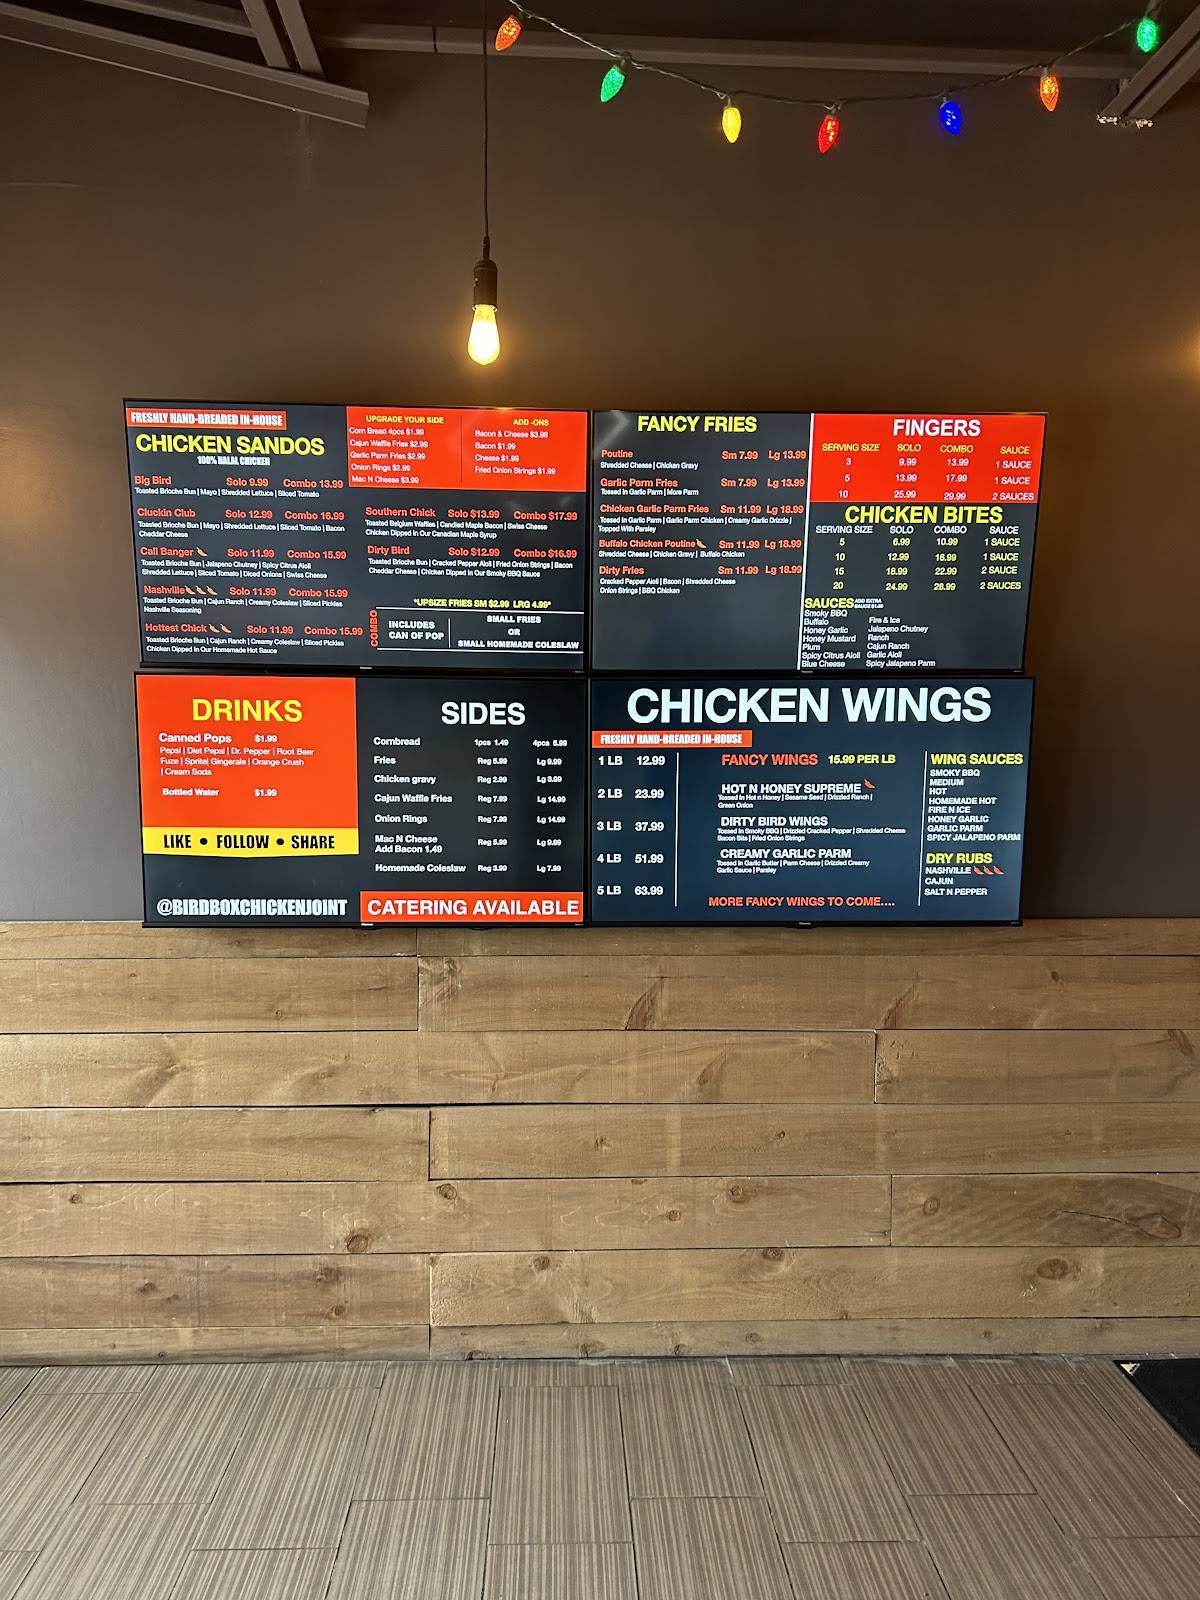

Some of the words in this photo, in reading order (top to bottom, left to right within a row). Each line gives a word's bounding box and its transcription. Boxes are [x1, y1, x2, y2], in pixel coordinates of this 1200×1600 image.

[131, 412, 168, 423] FRESHLY
[170, 413, 238, 425] HAND-BREADED
[240, 415, 282, 426] IN-HOUSE
[638, 416, 699, 432] FANCY
[704, 417, 757, 432] FRIES
[893, 420, 981, 436] FINGERS
[136, 434, 231, 453] CHICKEN
[237, 437, 325, 456] SANDOS
[822, 444, 859, 452] SERVING
[861, 444, 880, 452] SIZE
[897, 444, 921, 452] SOLO
[940, 445, 973, 453] COMBO
[601, 450, 633, 458] Poutine
[722, 451, 737, 459] Sm
[739, 451, 758, 459] 7.99
[769, 451, 781, 460] Lg
[783, 451, 806, 459] 13.99
[197, 456, 217, 465] 100%
[217, 456, 238, 465] HALAL
[240, 457, 270, 466] CHICKEN
[372, 465, 390, 473] Rings
[134, 476, 149, 486] Big
[152, 476, 171, 485] Bird
[226, 478, 247, 486] Solo
[249, 478, 268, 486] 9.99
[283, 479, 317, 488] Combo
[319, 480, 343, 488] 13.99
[896, 474, 917, 482] 13.99
[160, 488, 183, 496] Brioche
[200, 489, 217, 497] Mayo
[366, 508, 407, 517] Southern
[410, 508, 436, 517] Chick
[448, 509, 468, 518] Solo
[471, 510, 499, 519] $13.99
[514, 511, 546, 520] Combo
[548, 512, 578, 521] $17.99
[845, 506, 937, 523] CHICKEN
[944, 506, 1003, 523] BITES
[599, 567, 620, 575] Dirty
[718, 566, 733, 574] Sm
[735, 566, 758, 574] 11.99
[766, 566, 777, 576] Lg
[779, 566, 802, 574] 18.99
[833, 582, 843, 590] 20
[980, 582, 985, 590] 2
[987, 582, 1021, 590] SAUCES
[805, 599, 854, 608] SAUCES
[146, 624, 179, 632] Hottest
[181, 624, 207, 632] Chick
[247, 625, 267, 634] Solo
[270, 625, 293, 634] 11.99
[305, 626, 337, 635] Combo
[340, 627, 363, 635] 15.99
[369, 610, 378, 646] COMBO
[389, 621, 435, 629] INCLUDES
[389, 632, 410, 640] CAN
[412, 632, 424, 640] OF
[425, 632, 444, 640] POP
[867, 643, 887, 651] Cajun
[627, 687, 829, 723] CHICKEN
[842, 687, 991, 723] WINGS
[192, 699, 302, 722] DRINKS
[441, 702, 525, 725] SIDES
[159, 734, 201, 742] Canned
[204, 734, 232, 744] Pops
[255, 734, 277, 743] $1.99
[374, 738, 420, 746] Cornbread
[474, 739, 491, 747] 1pcs
[601, 735, 635, 744] FRESHLY
[637, 734, 701, 744] HAND-BREADED
[703, 734, 743, 744] IN-HOUSE
[160, 747, 181, 755] Pepsi
[244, 748, 271, 756] Pepper
[598, 757, 604, 765] 1
[608, 757, 623, 765] LB
[636, 757, 665, 765] 12.99
[722, 755, 768, 765] FANCY
[772, 755, 818, 765] WINGS
[828, 755, 855, 763] 15.99
[857, 755, 879, 763] PER
[881, 755, 896, 763] LB
[931, 754, 966, 764] WING
[970, 754, 1023, 764] SAUCES
[163, 788, 192, 796] Bottled
[255, 789, 277, 797] $1.99
[598, 790, 605, 798] 2
[607, 789, 623, 798] LB
[635, 790, 664, 798] 23.99
[722, 784, 747, 793] HOT
[749, 784, 757, 793] N
[761, 784, 801, 793] HONEY
[804, 784, 861, 793] SUPREME
[164, 835, 192, 848] LIKE
[217, 835, 269, 848] FOLLOW
[291, 836, 335, 848] SHARE
[926, 853, 953, 863] DRY
[956, 853, 992, 863] RUBS
[376, 864, 425, 872] Homemade
[427, 864, 466, 872] Coleslaw
[709, 898, 743, 906] MORE
[746, 897, 784, 906] FANCY
[787, 897, 825, 906] WINGS
[827, 897, 843, 906] TO
[846, 897, 895, 906] COME....
[157, 899, 347, 915] @BIRDBOXCHICKENJOINT
[368, 900, 467, 915] CATERING
[473, 900, 579, 915] AVAILABLE
